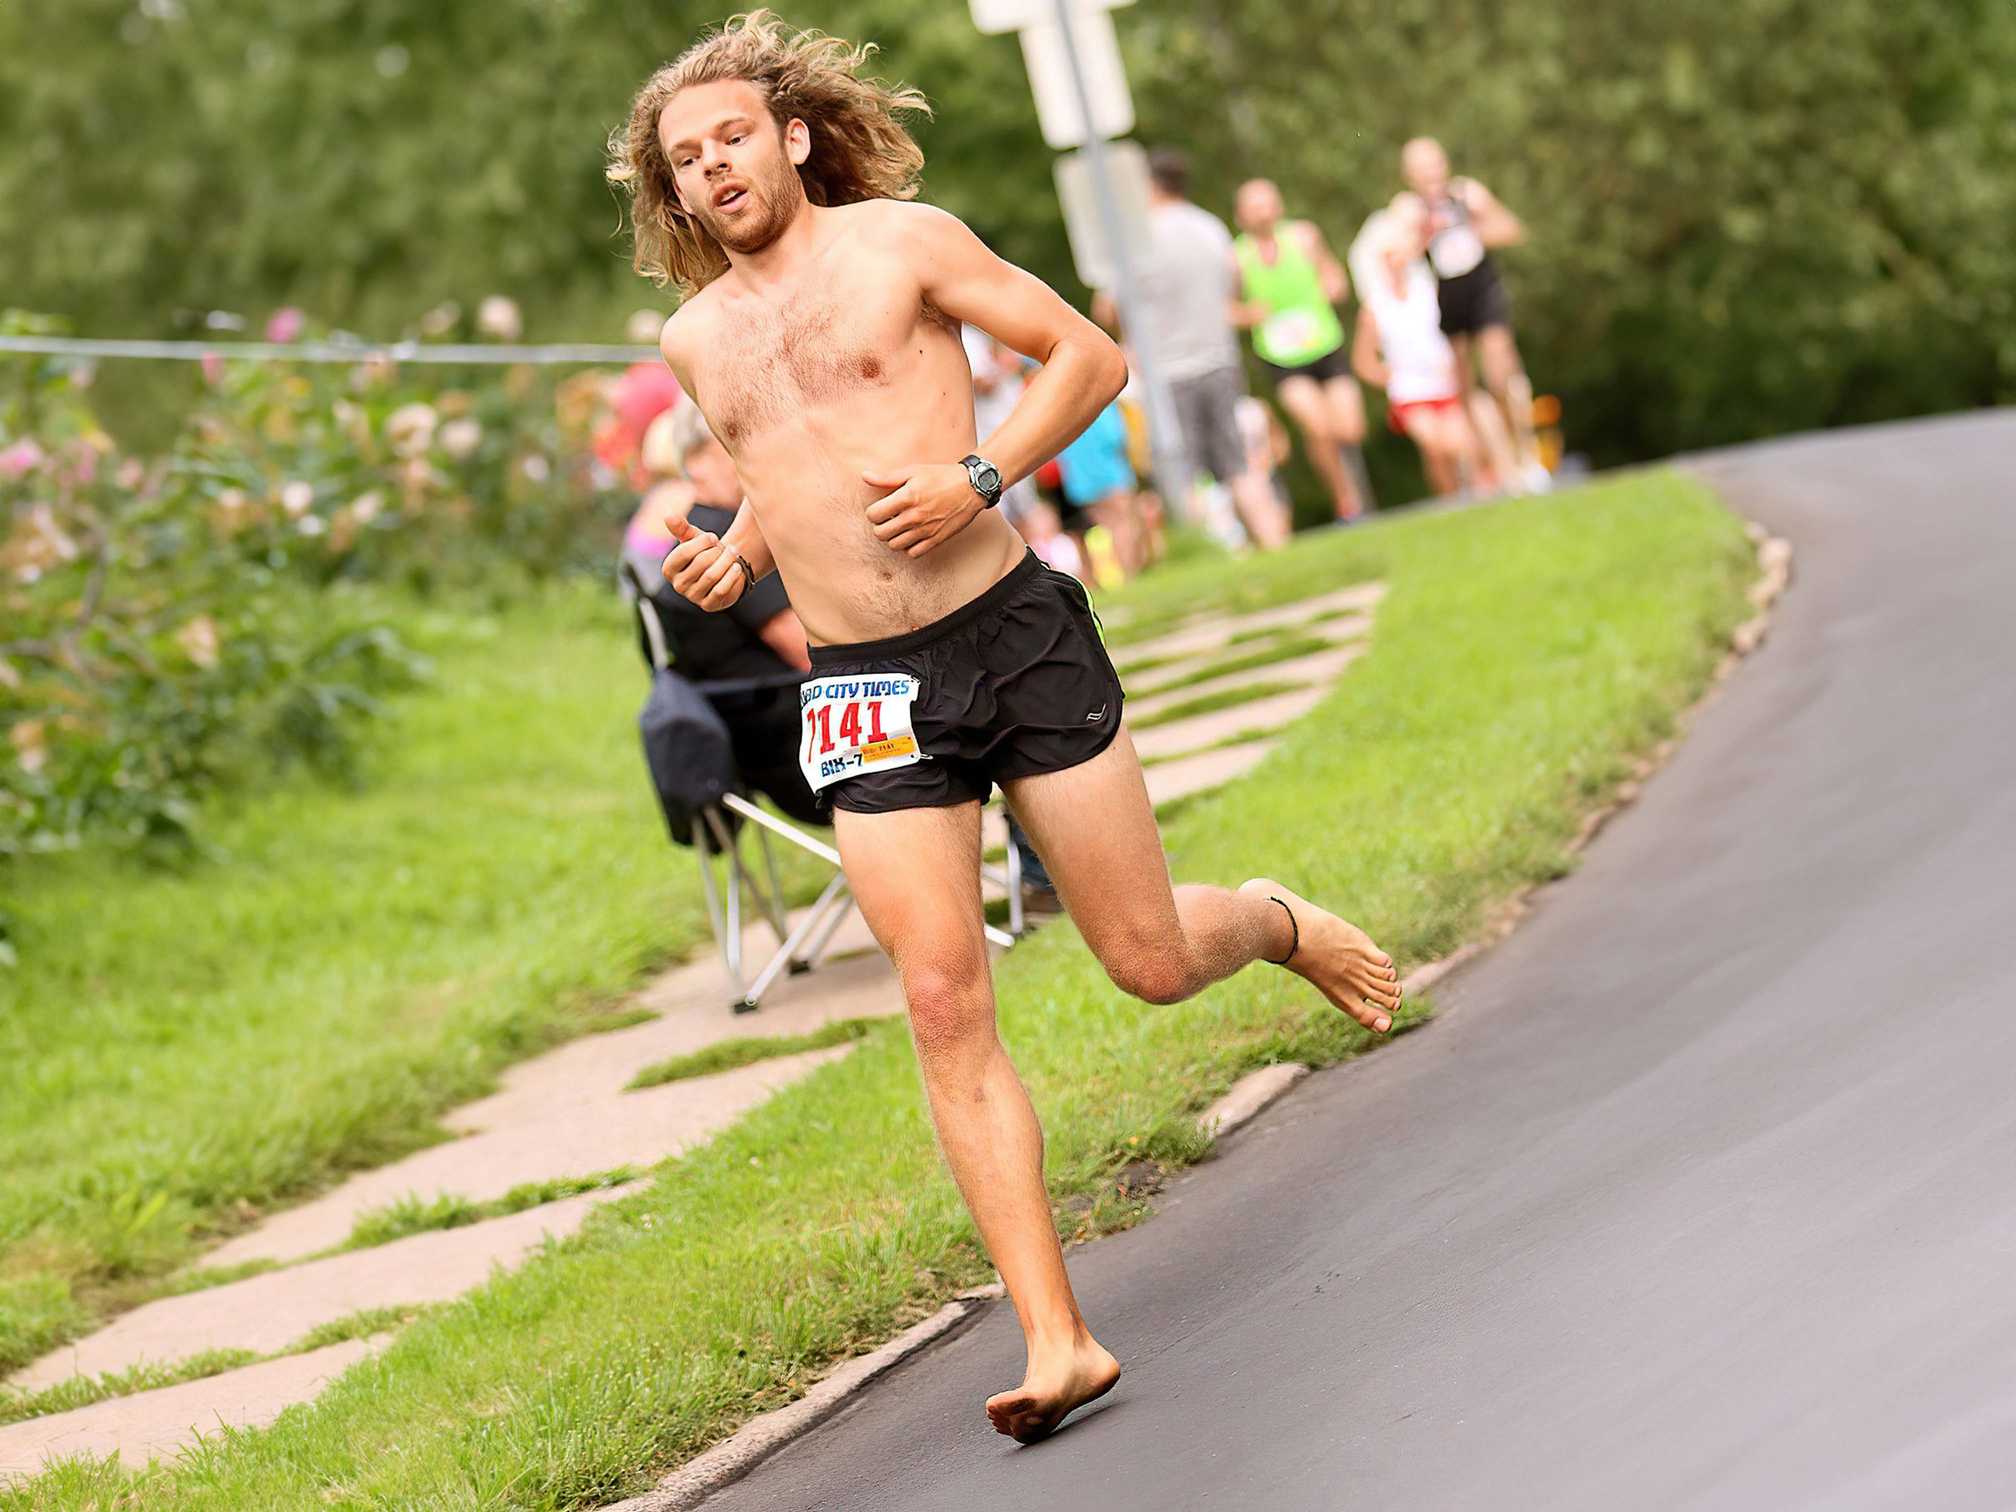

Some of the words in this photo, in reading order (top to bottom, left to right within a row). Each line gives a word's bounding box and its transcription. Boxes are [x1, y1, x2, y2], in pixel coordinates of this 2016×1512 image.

[826, 682, 860, 699] CITY
[863, 680, 910, 697] TIMES
[820, 754, 863, 777] BIX-7
